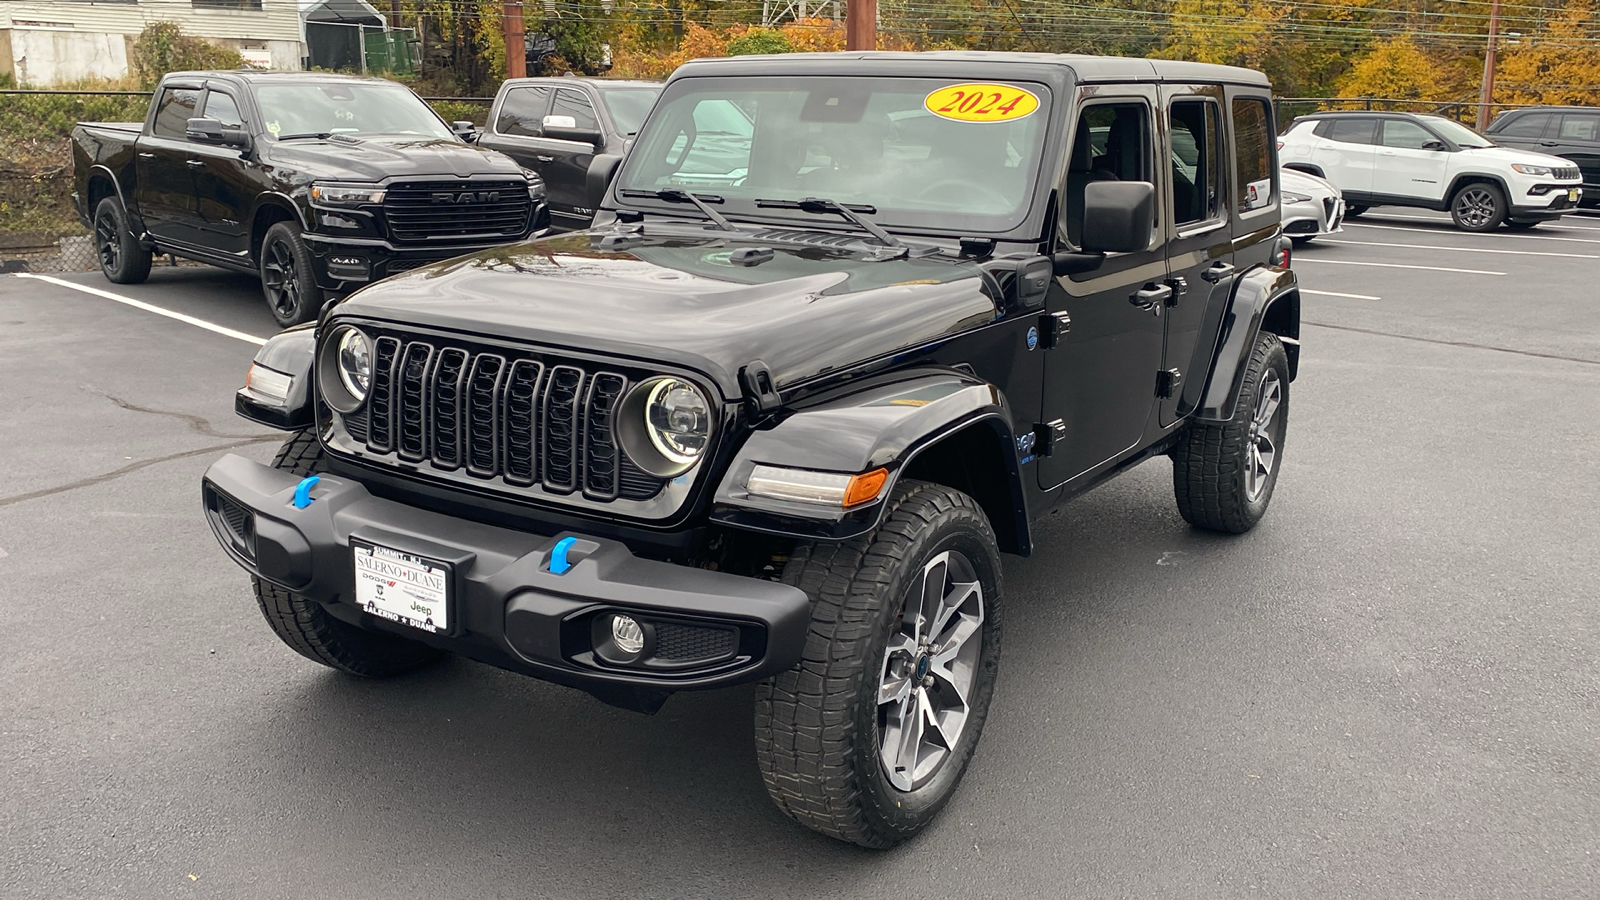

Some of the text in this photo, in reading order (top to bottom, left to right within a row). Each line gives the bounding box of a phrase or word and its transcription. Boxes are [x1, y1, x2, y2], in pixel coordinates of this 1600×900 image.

[937, 91, 1026, 115] 2024
[432, 191, 499, 203] RAM
[357, 556, 443, 591] SALERNO DUANE
[363, 605, 436, 633] SALERNO DUANE
[410, 601, 432, 616] Jeep
